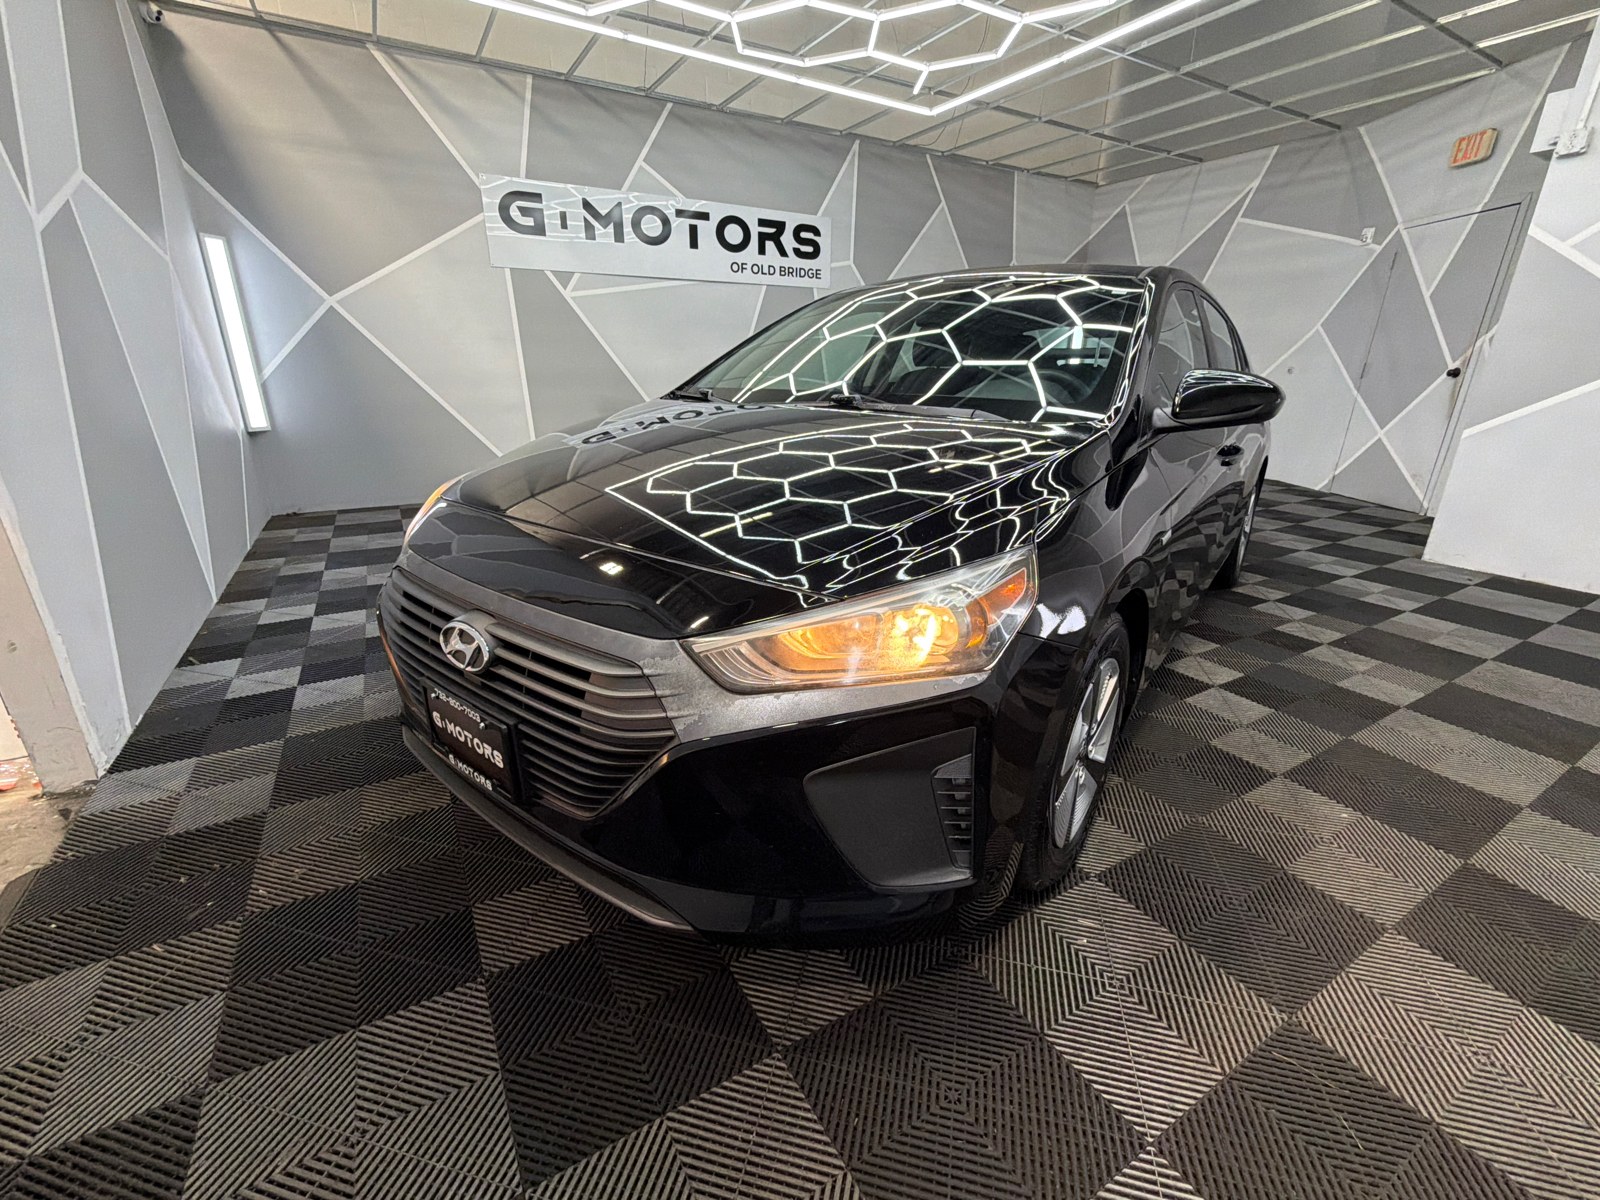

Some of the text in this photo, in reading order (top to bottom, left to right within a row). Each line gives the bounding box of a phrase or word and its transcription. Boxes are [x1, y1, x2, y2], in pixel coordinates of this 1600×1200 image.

[1452, 130, 1488, 164] EXIT
[730, 261, 822, 280] OF OLD BRIDGE
